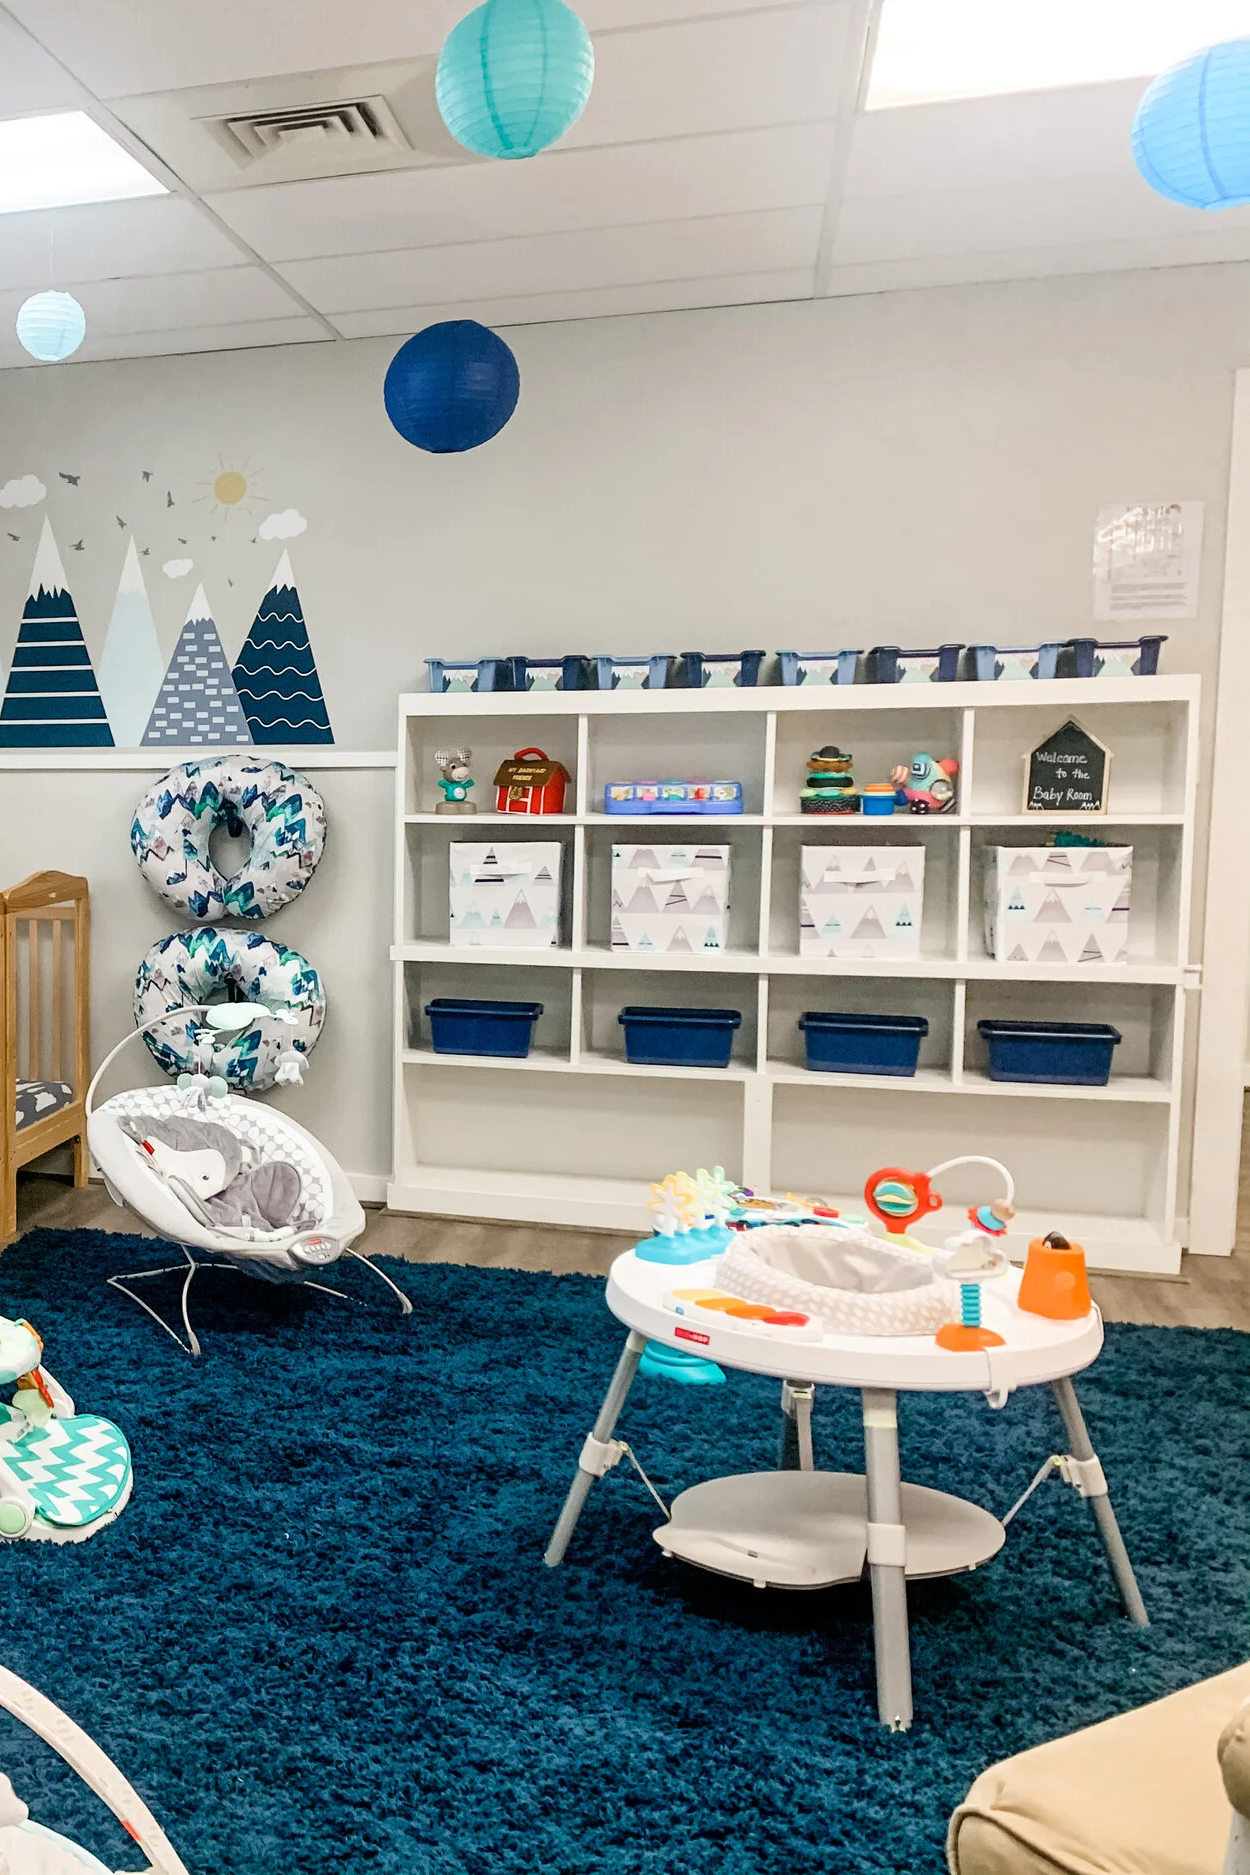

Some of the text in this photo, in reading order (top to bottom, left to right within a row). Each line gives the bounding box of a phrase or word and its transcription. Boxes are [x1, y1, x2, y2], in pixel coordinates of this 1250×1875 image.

[1036, 752, 1087, 763] Welcome
[1055, 768, 1090, 779] to the
[1033, 786, 1092, 806] Baby Room
